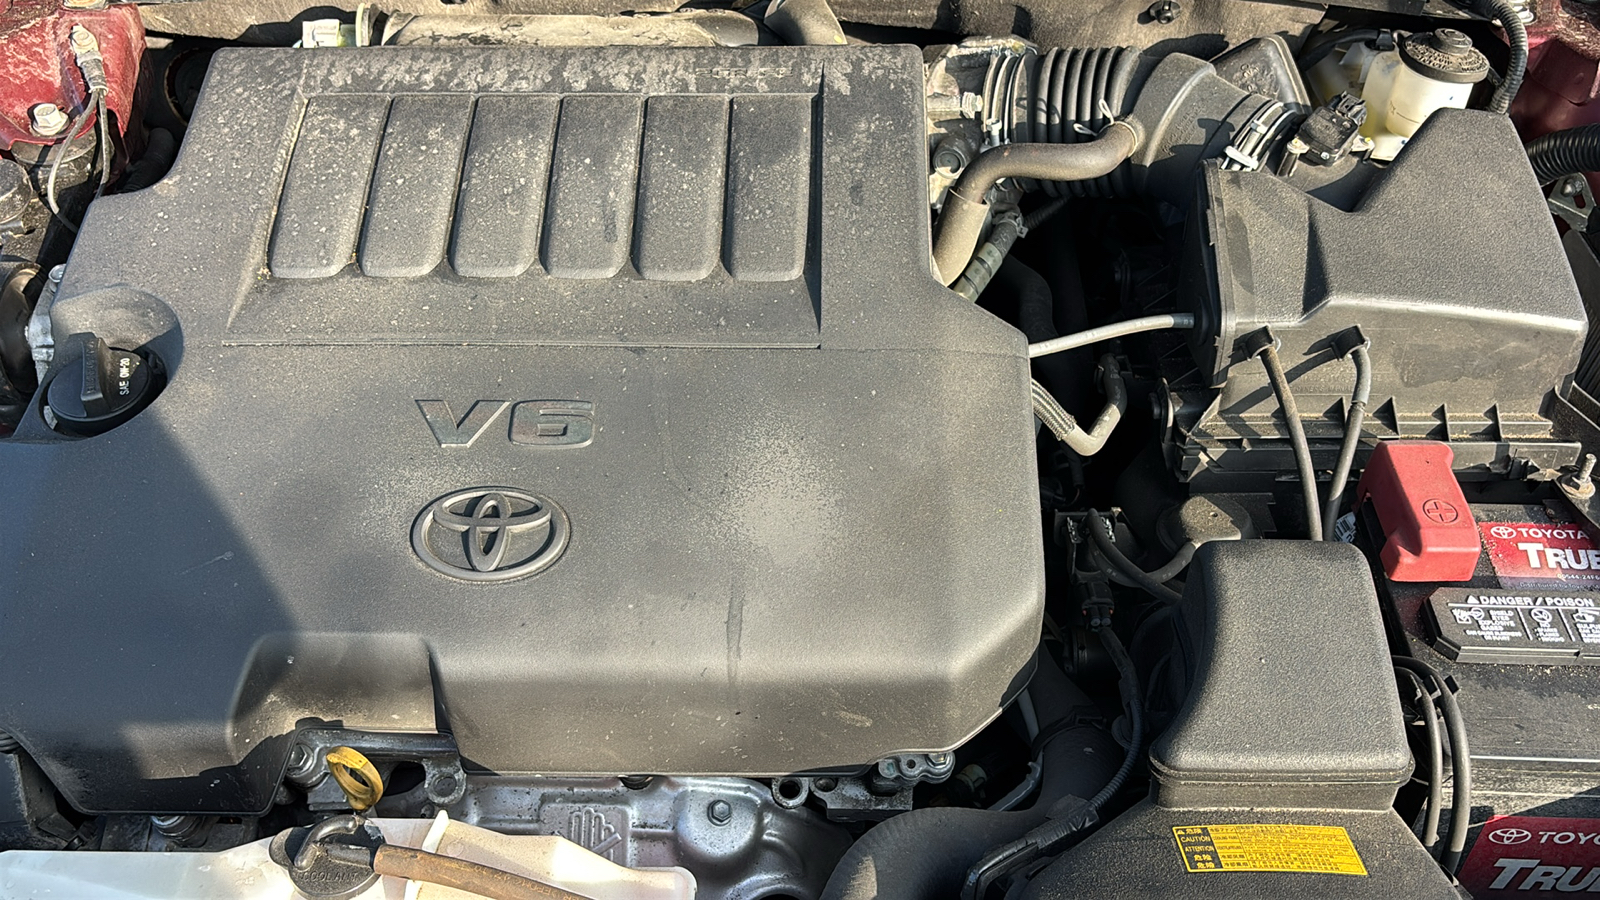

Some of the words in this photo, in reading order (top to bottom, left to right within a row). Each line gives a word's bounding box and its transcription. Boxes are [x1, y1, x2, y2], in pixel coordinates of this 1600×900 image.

[120, 358, 130, 378] 0W-20
[119, 380, 130, 395] SAE
[414, 399, 595, 449] V6
[1517, 528, 1589, 540] TOYOTA
[1479, 596, 1533, 605] DANGER
[1545, 597, 1595, 607] POISON
